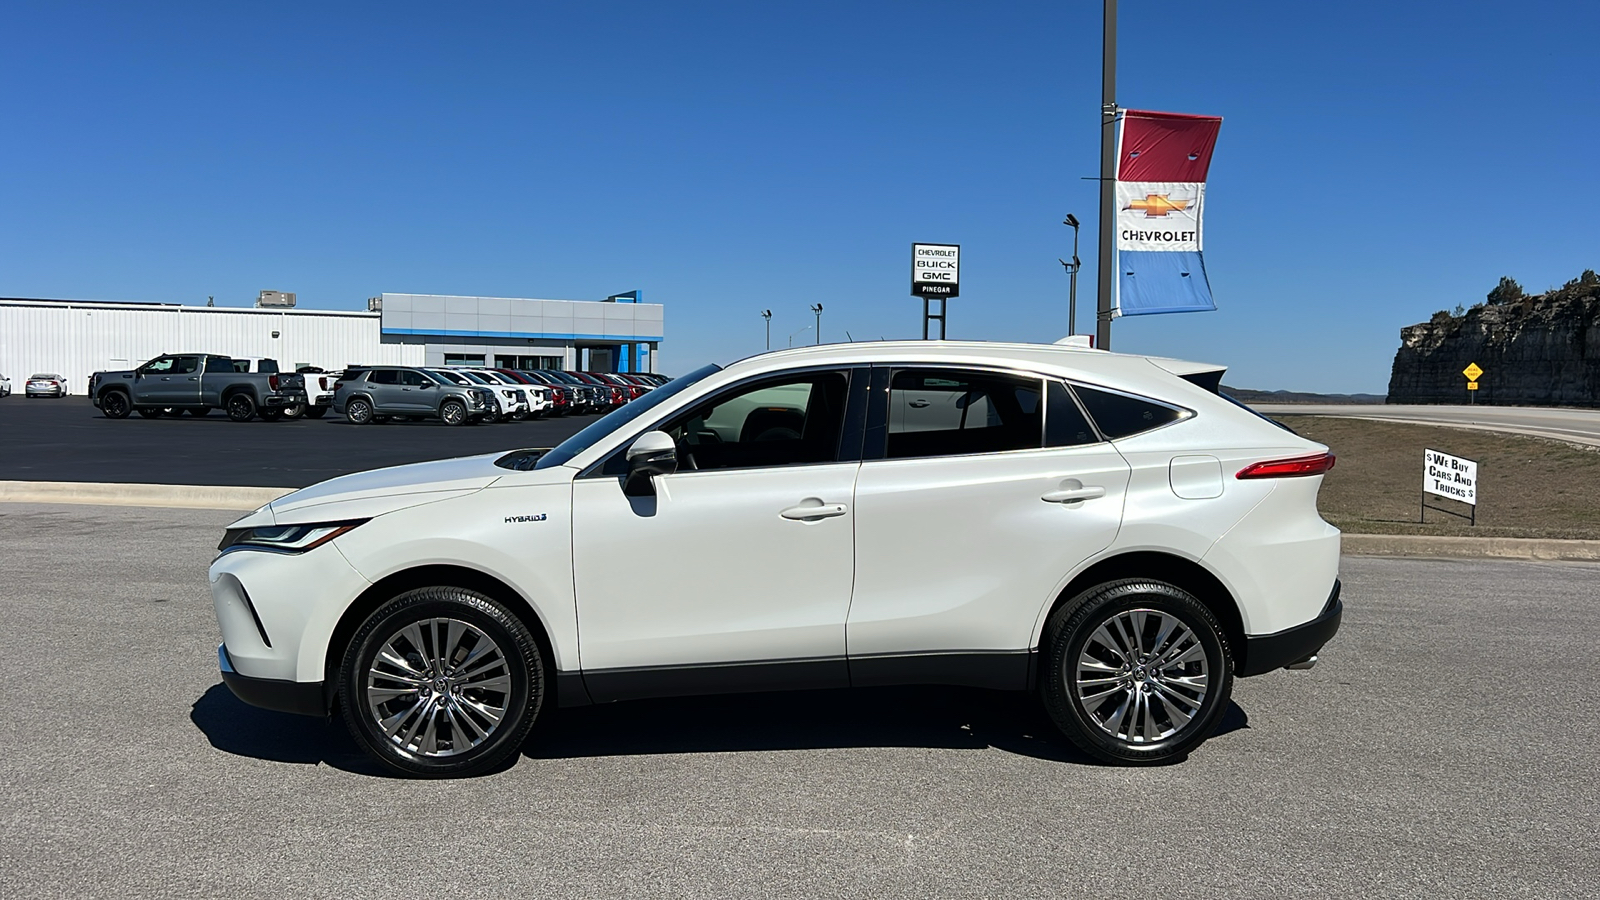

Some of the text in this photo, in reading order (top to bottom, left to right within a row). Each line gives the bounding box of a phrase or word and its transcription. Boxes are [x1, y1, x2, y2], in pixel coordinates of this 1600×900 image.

[1122, 230, 1195, 242] CHEVROLET
[918, 249, 956, 257] CHEVROLET
[917, 260, 956, 269] BUICK
[922, 272, 951, 280] GMC
[504, 514, 540, 523] HYBRID
